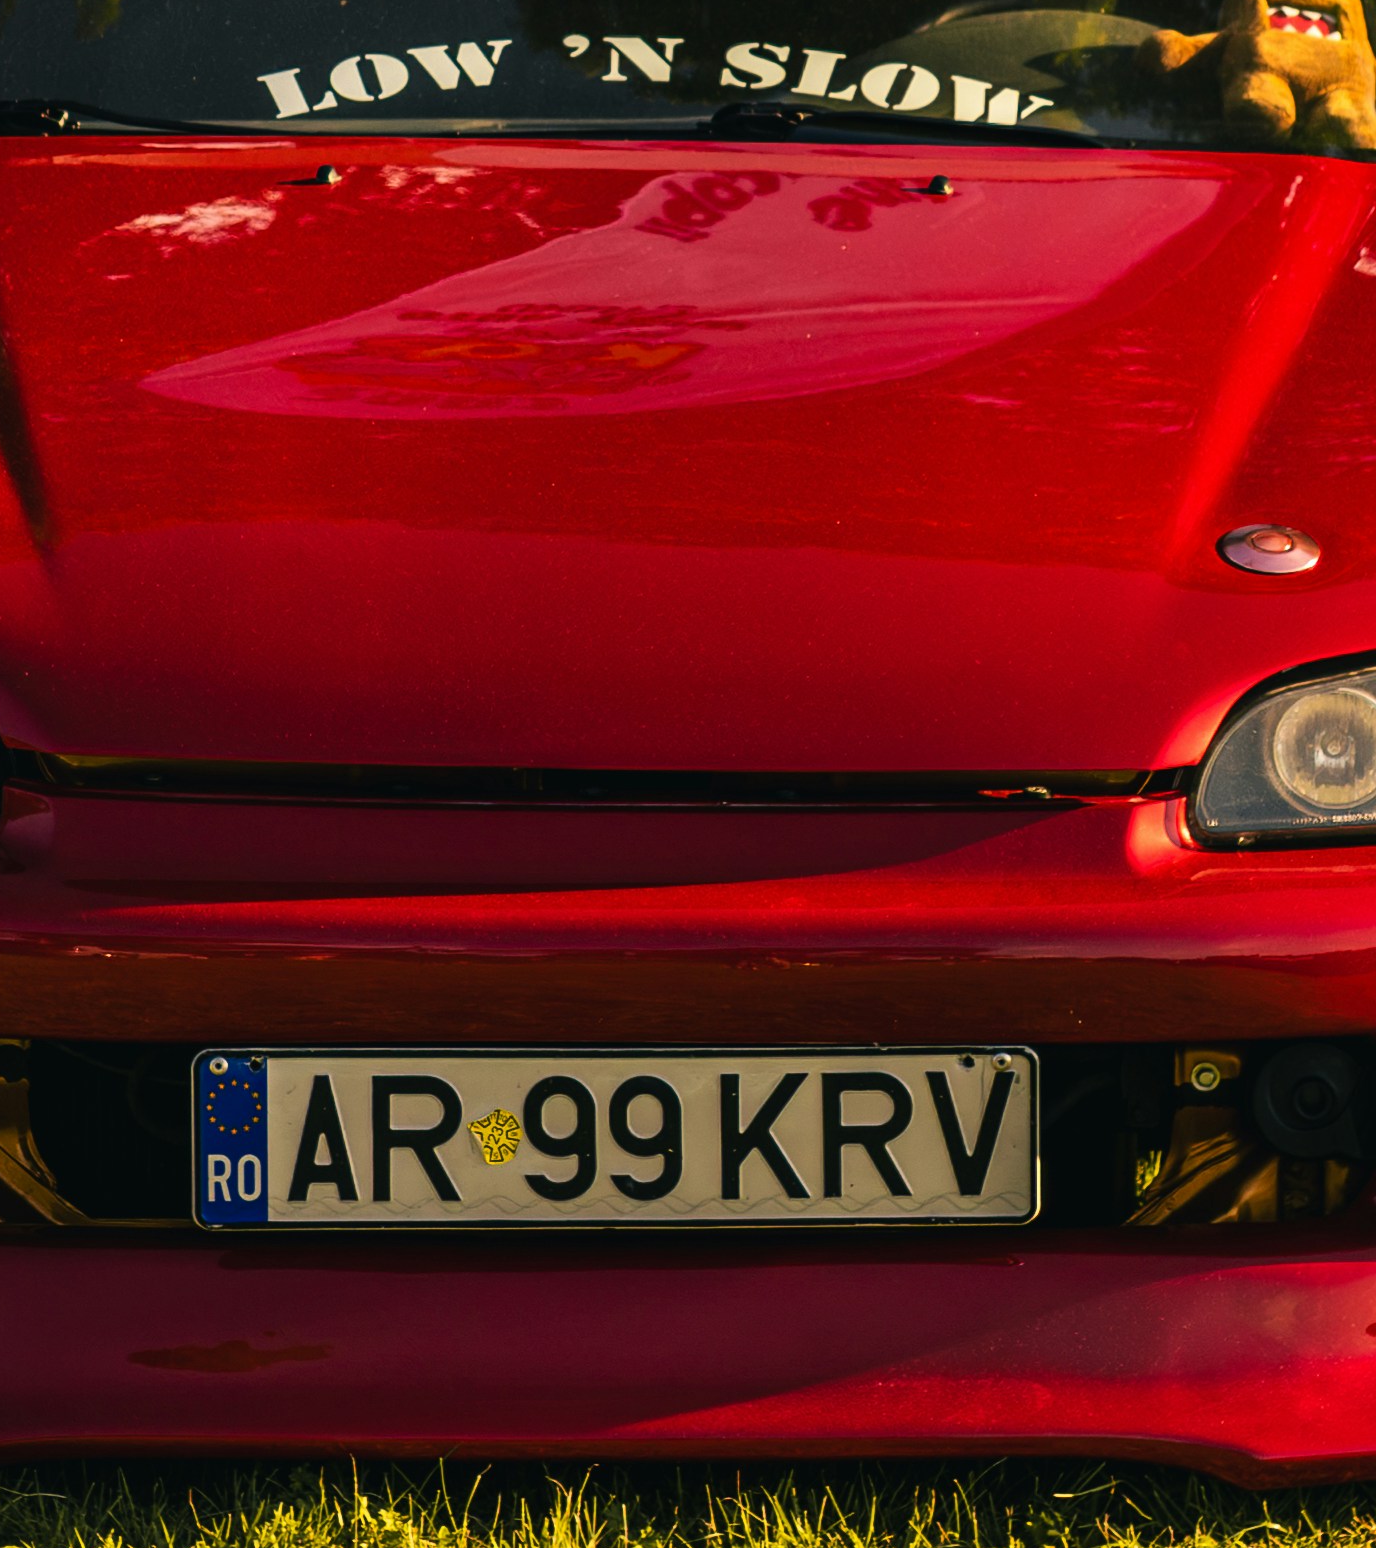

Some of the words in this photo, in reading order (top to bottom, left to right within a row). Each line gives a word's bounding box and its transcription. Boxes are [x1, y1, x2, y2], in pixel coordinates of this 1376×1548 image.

[256, 38, 513, 120] LOW
[719, 42, 1056, 127] SLOW
[206, 1153, 263, 1202] RO
[286, 1073, 463, 1202] AR
[521, 1074, 684, 1201] 99
[718, 1067, 1015, 1201] KRV
